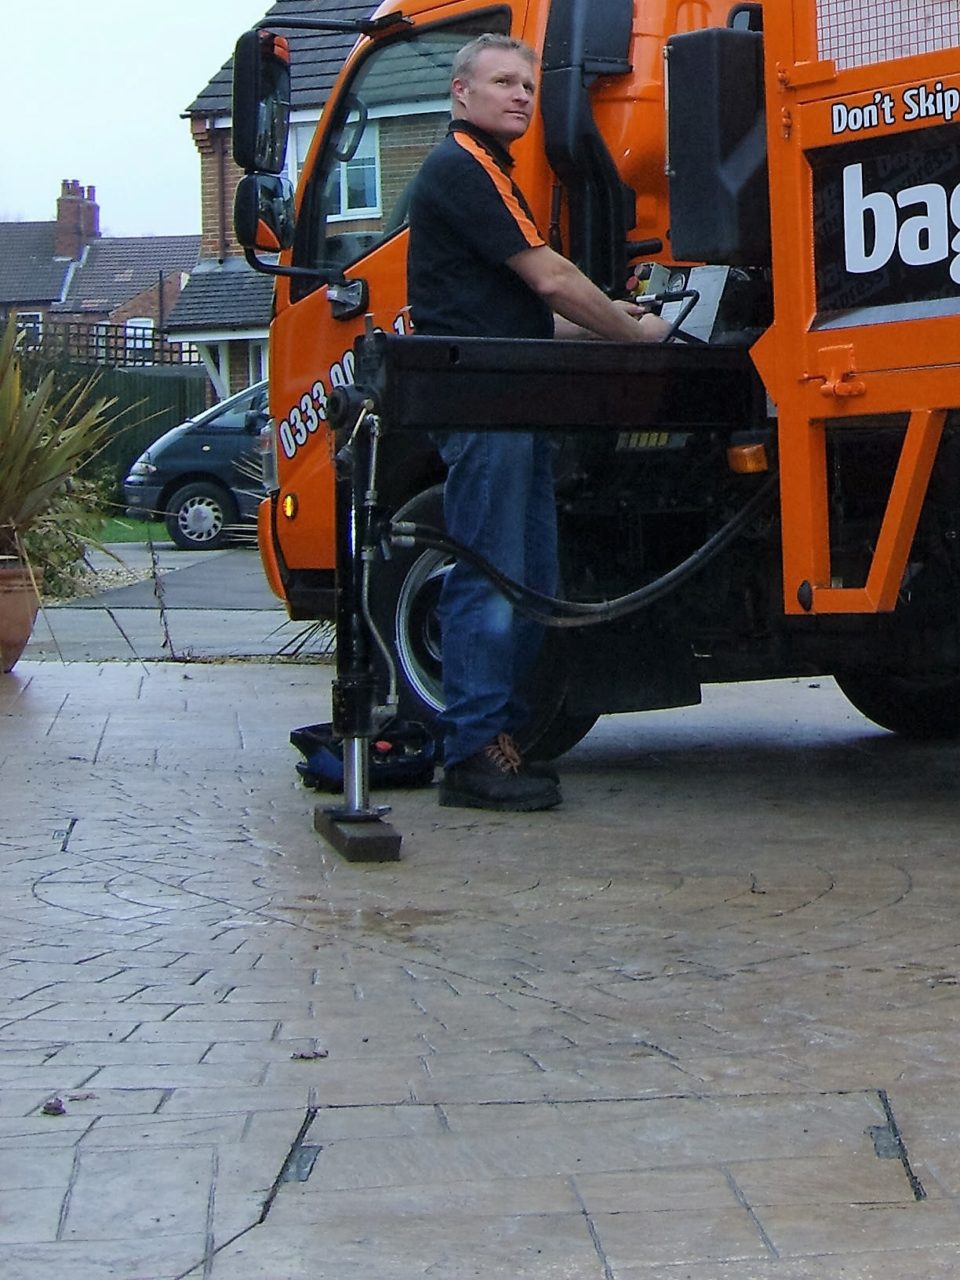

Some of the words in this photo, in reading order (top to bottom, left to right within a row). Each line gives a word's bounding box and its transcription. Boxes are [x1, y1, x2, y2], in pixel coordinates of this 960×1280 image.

[832, 91, 895, 134] Don't
[903, 82, 960, 122] Skip
[279, 380, 328, 459] 0333
